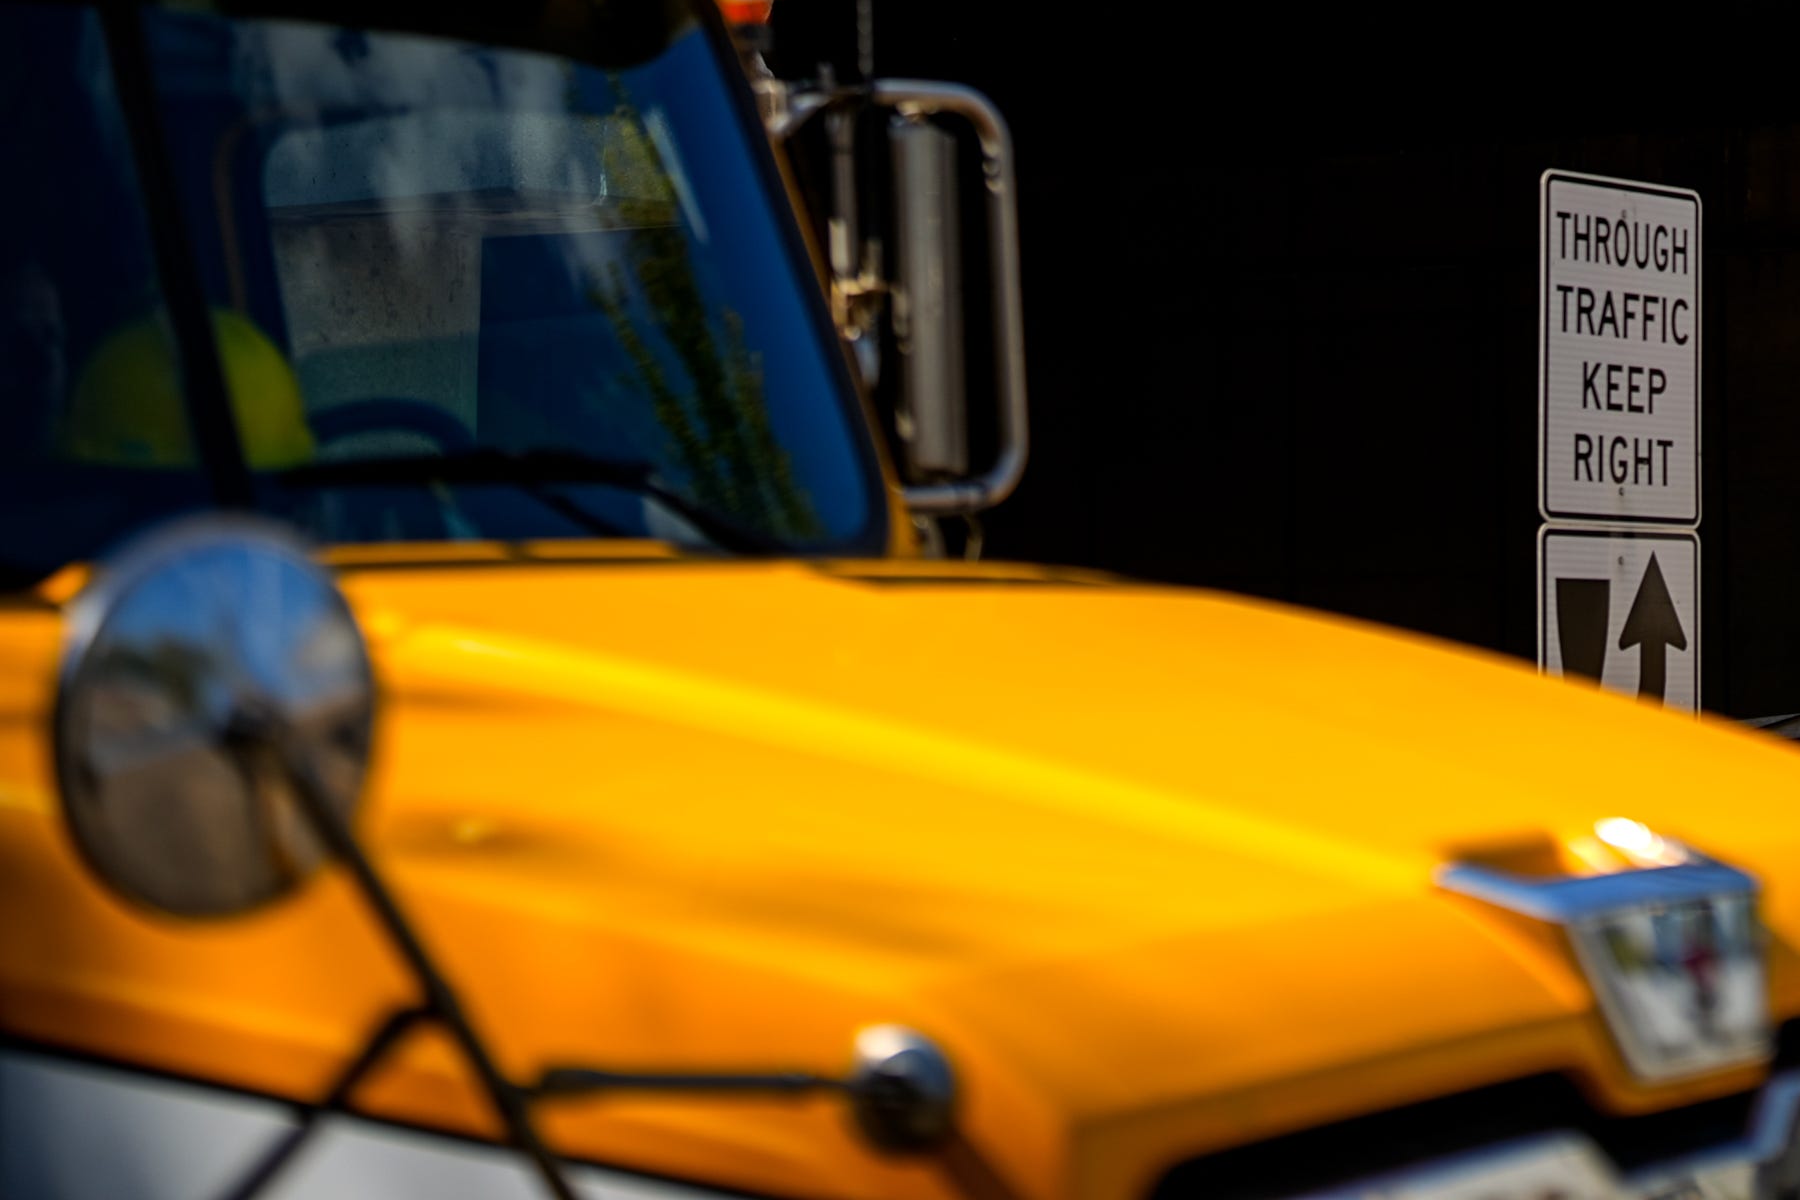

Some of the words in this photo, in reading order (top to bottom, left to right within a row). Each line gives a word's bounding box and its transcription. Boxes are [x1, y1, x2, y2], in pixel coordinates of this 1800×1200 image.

[1556, 211, 1688, 274] THROUGH
[1556, 285, 1689, 345] TRAFFIC
[1583, 362, 1667, 414] KEEP
[1574, 434, 1673, 486] RIGHT
